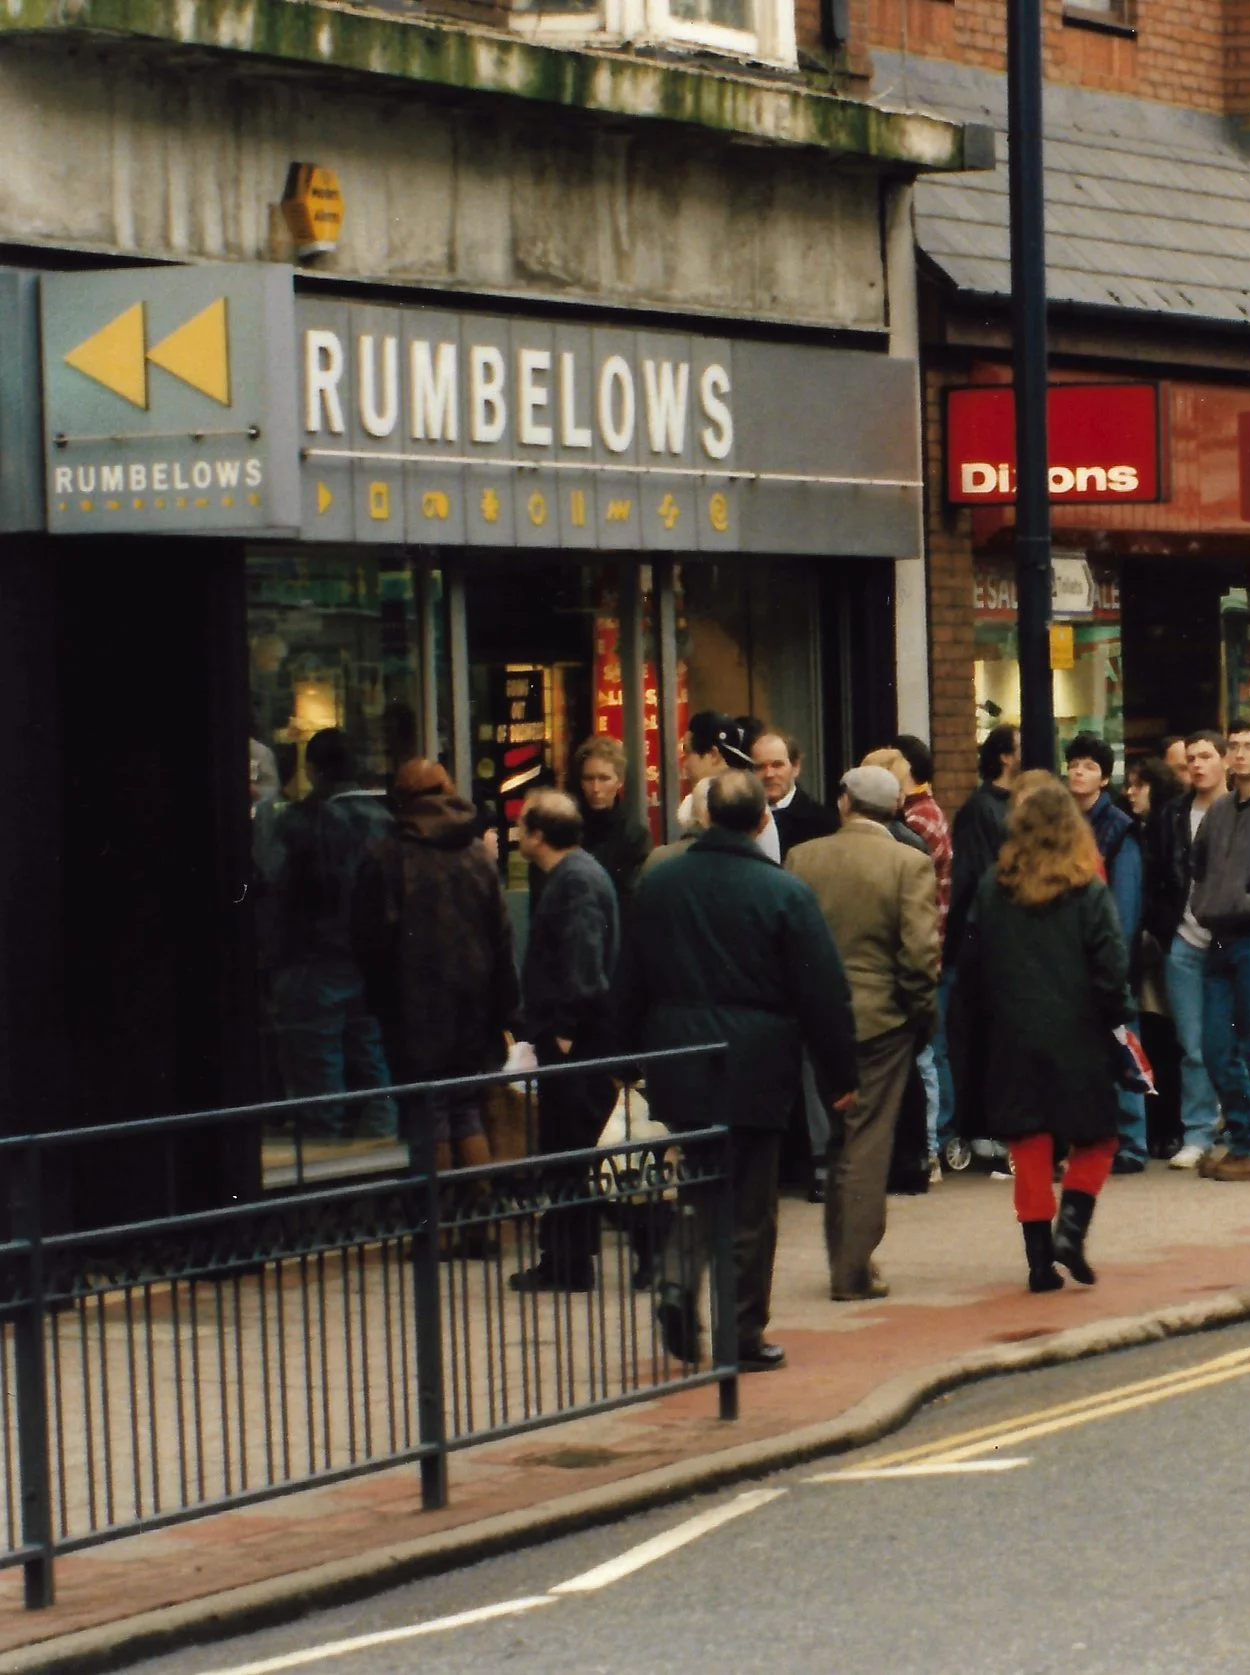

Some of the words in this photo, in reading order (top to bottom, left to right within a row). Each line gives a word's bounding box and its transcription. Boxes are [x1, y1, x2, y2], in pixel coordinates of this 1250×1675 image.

[305, 330, 734, 460] RUMBELOWS
[55, 459, 263, 494] RUMBELOWS
[961, 462, 1140, 494] Dions
